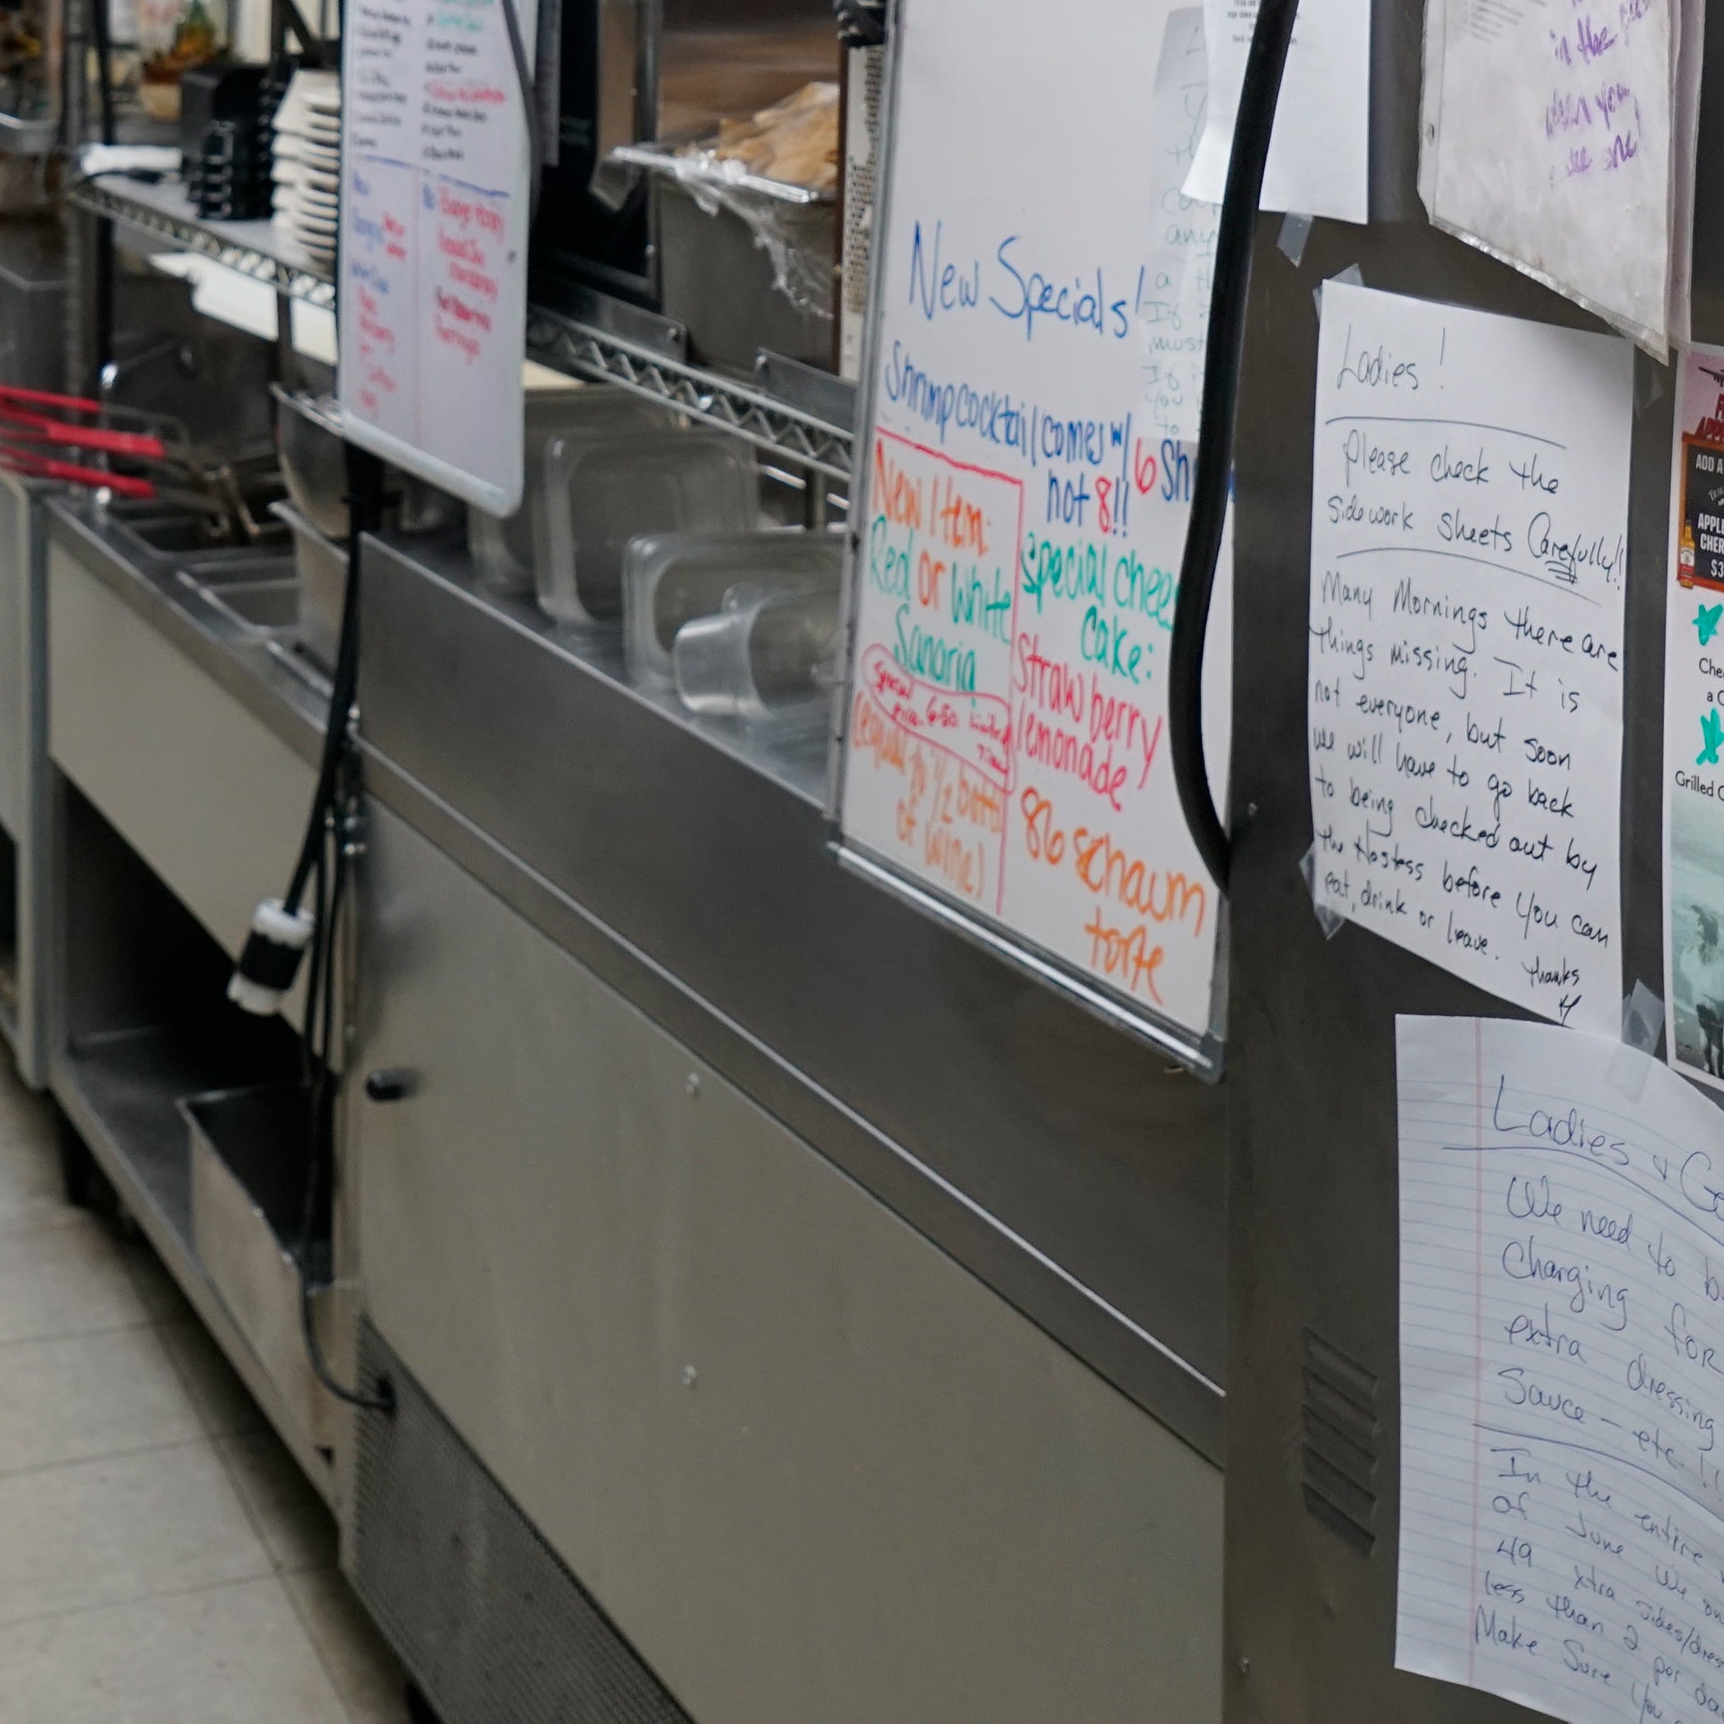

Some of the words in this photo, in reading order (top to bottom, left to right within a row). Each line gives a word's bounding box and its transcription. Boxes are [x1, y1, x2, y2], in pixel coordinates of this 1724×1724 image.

[909, 219, 979, 320] New
[1342, 428, 1411, 488] Please
[1508, 453, 1560, 495] the
[1696, 454, 1715, 472] ADD
[1717, 458, 1723, 474] A
[1046, 467, 1090, 526] not
[1321, 570, 1373, 621] Many
[1558, 678, 1579, 713] is
[1467, 712, 1506, 753] but
[1676, 770, 1714, 797] Grilled
[1020, 785, 1065, 866] 86
[1492, 1073, 1630, 1167] Ladies
[1580, 1208, 1634, 1246] need
[1504, 1302, 1587, 1358] extra
[1474, 1604, 1539, 1657] Make
